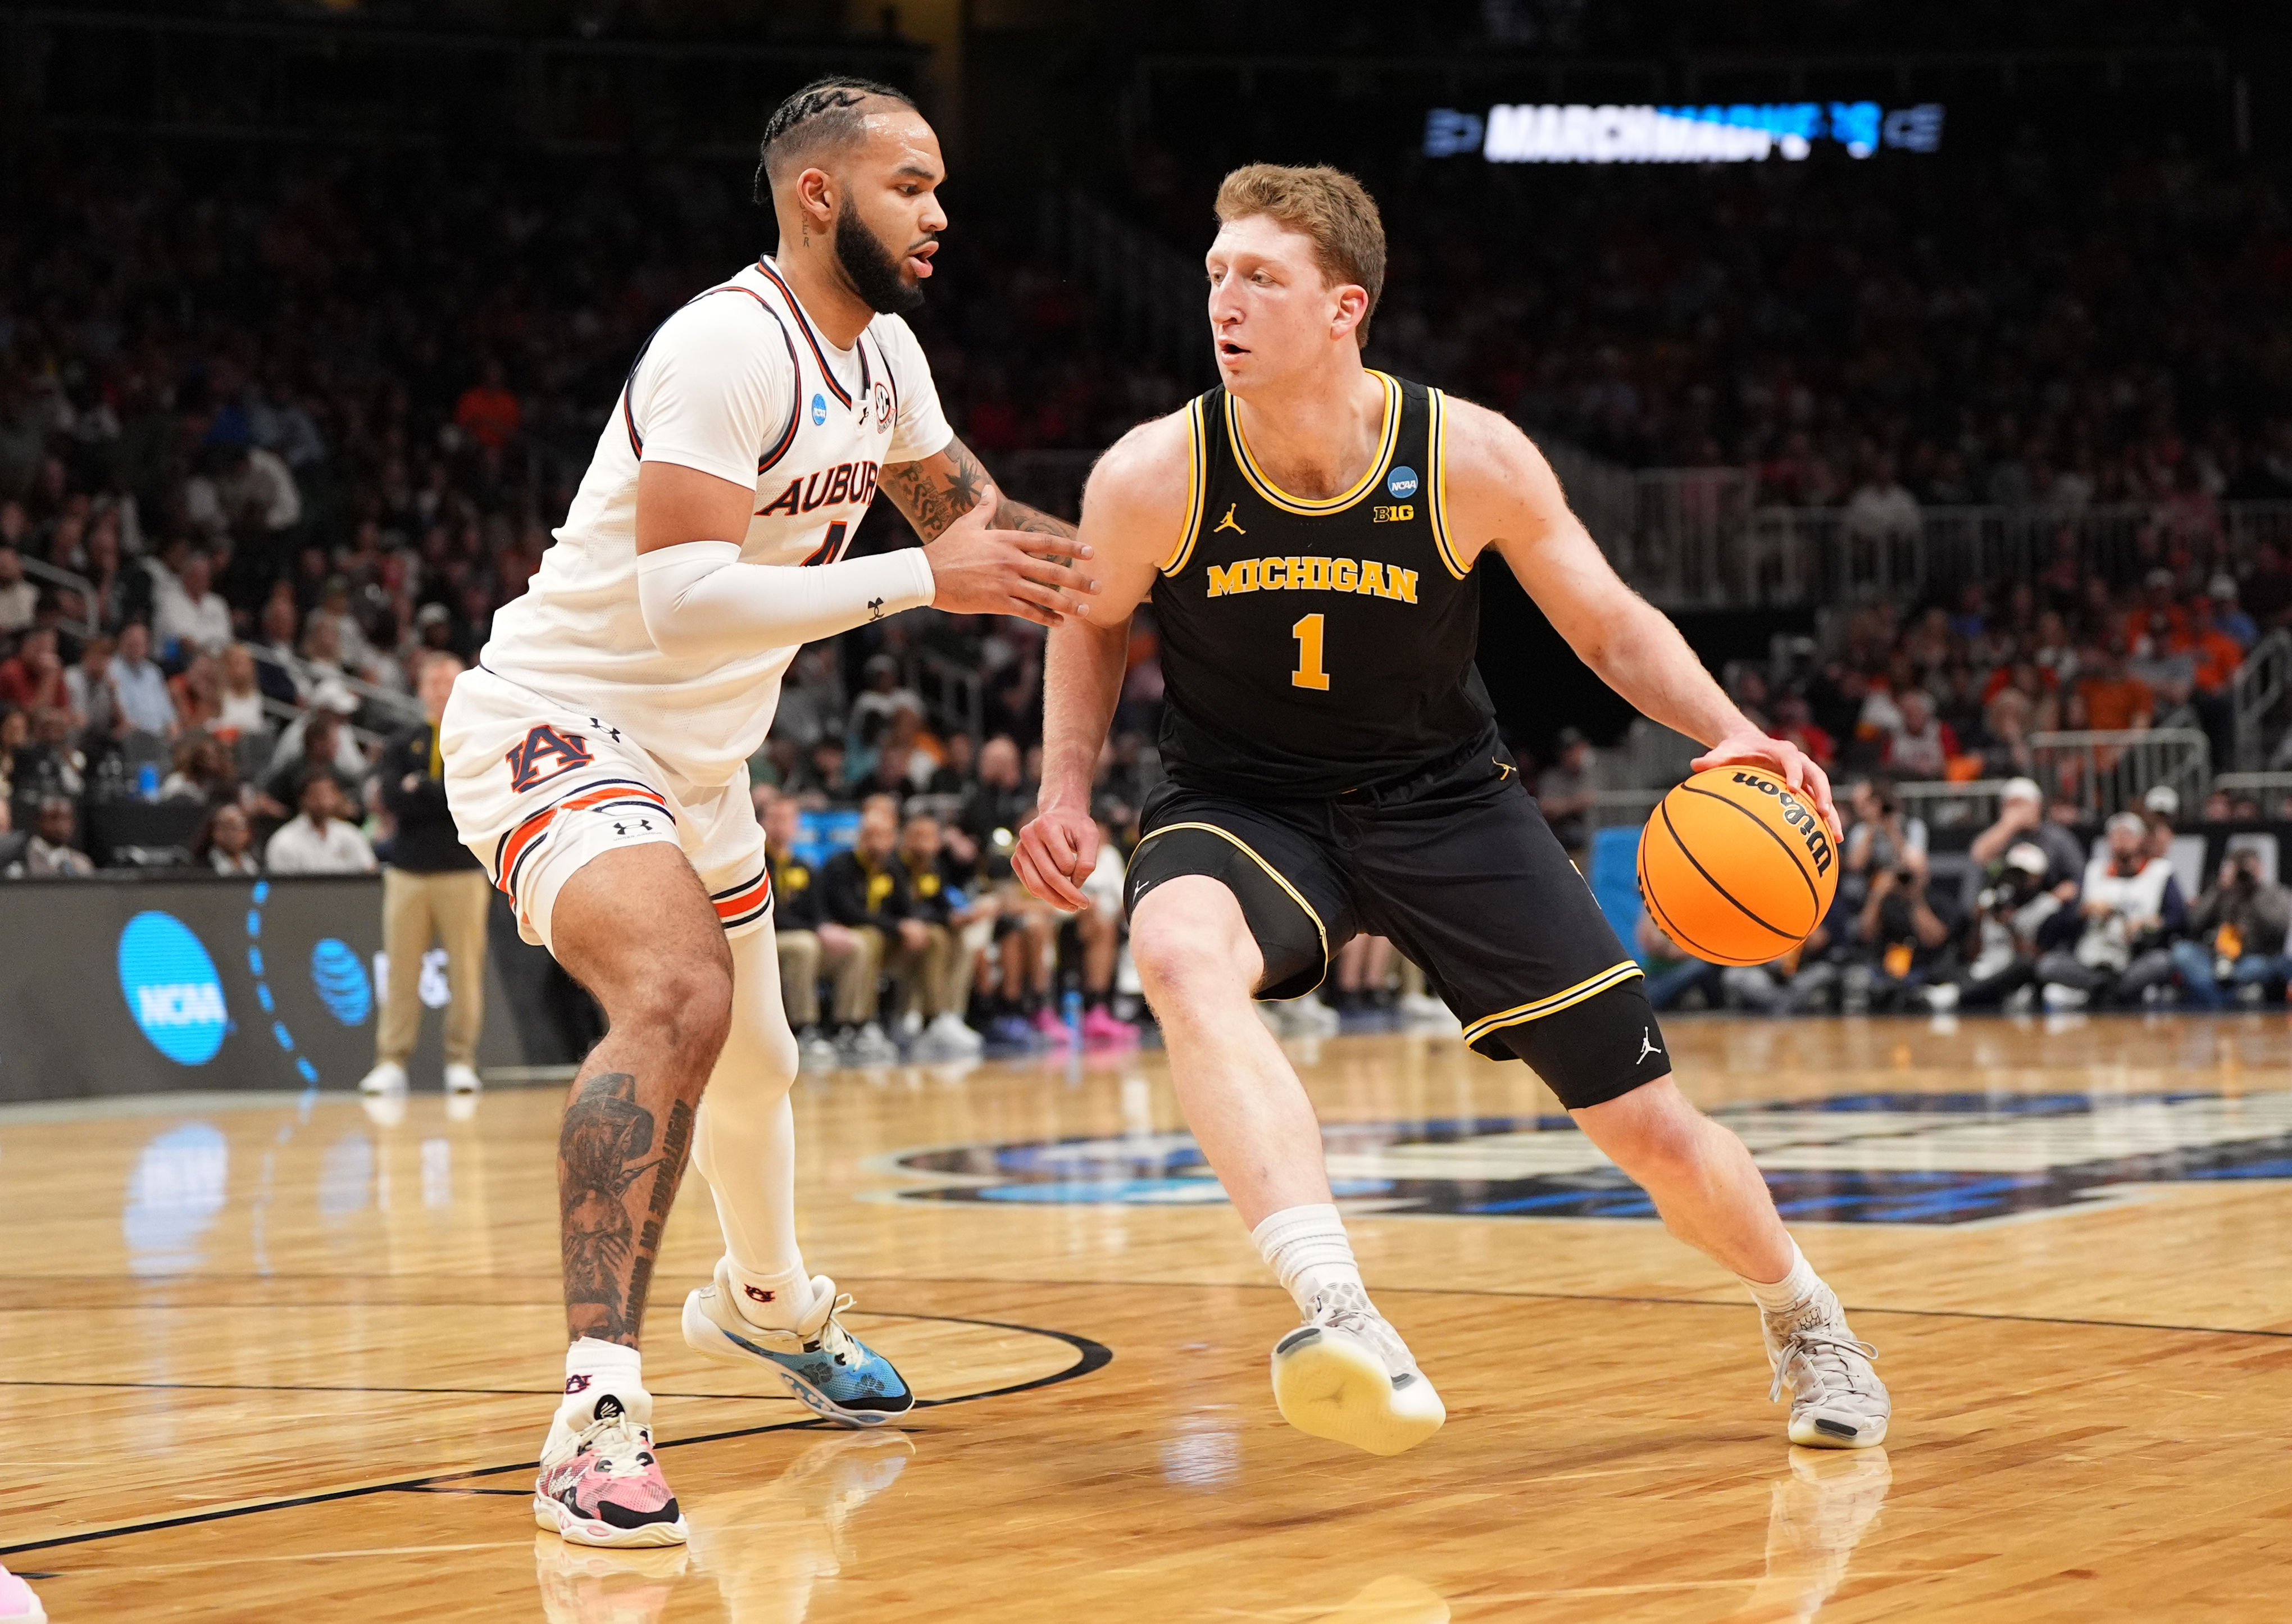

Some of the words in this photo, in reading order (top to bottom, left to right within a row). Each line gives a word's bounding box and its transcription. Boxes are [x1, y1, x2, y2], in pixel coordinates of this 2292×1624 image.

[754, 460, 881, 516] AUBUR
[1391, 480, 1416, 492] NCAA
[1207, 556, 1418, 604] MICHIGAN
[1292, 613, 1330, 691] 1
[1732, 772, 1831, 879] Wilson
[138, 983, 227, 1026] NCAA
